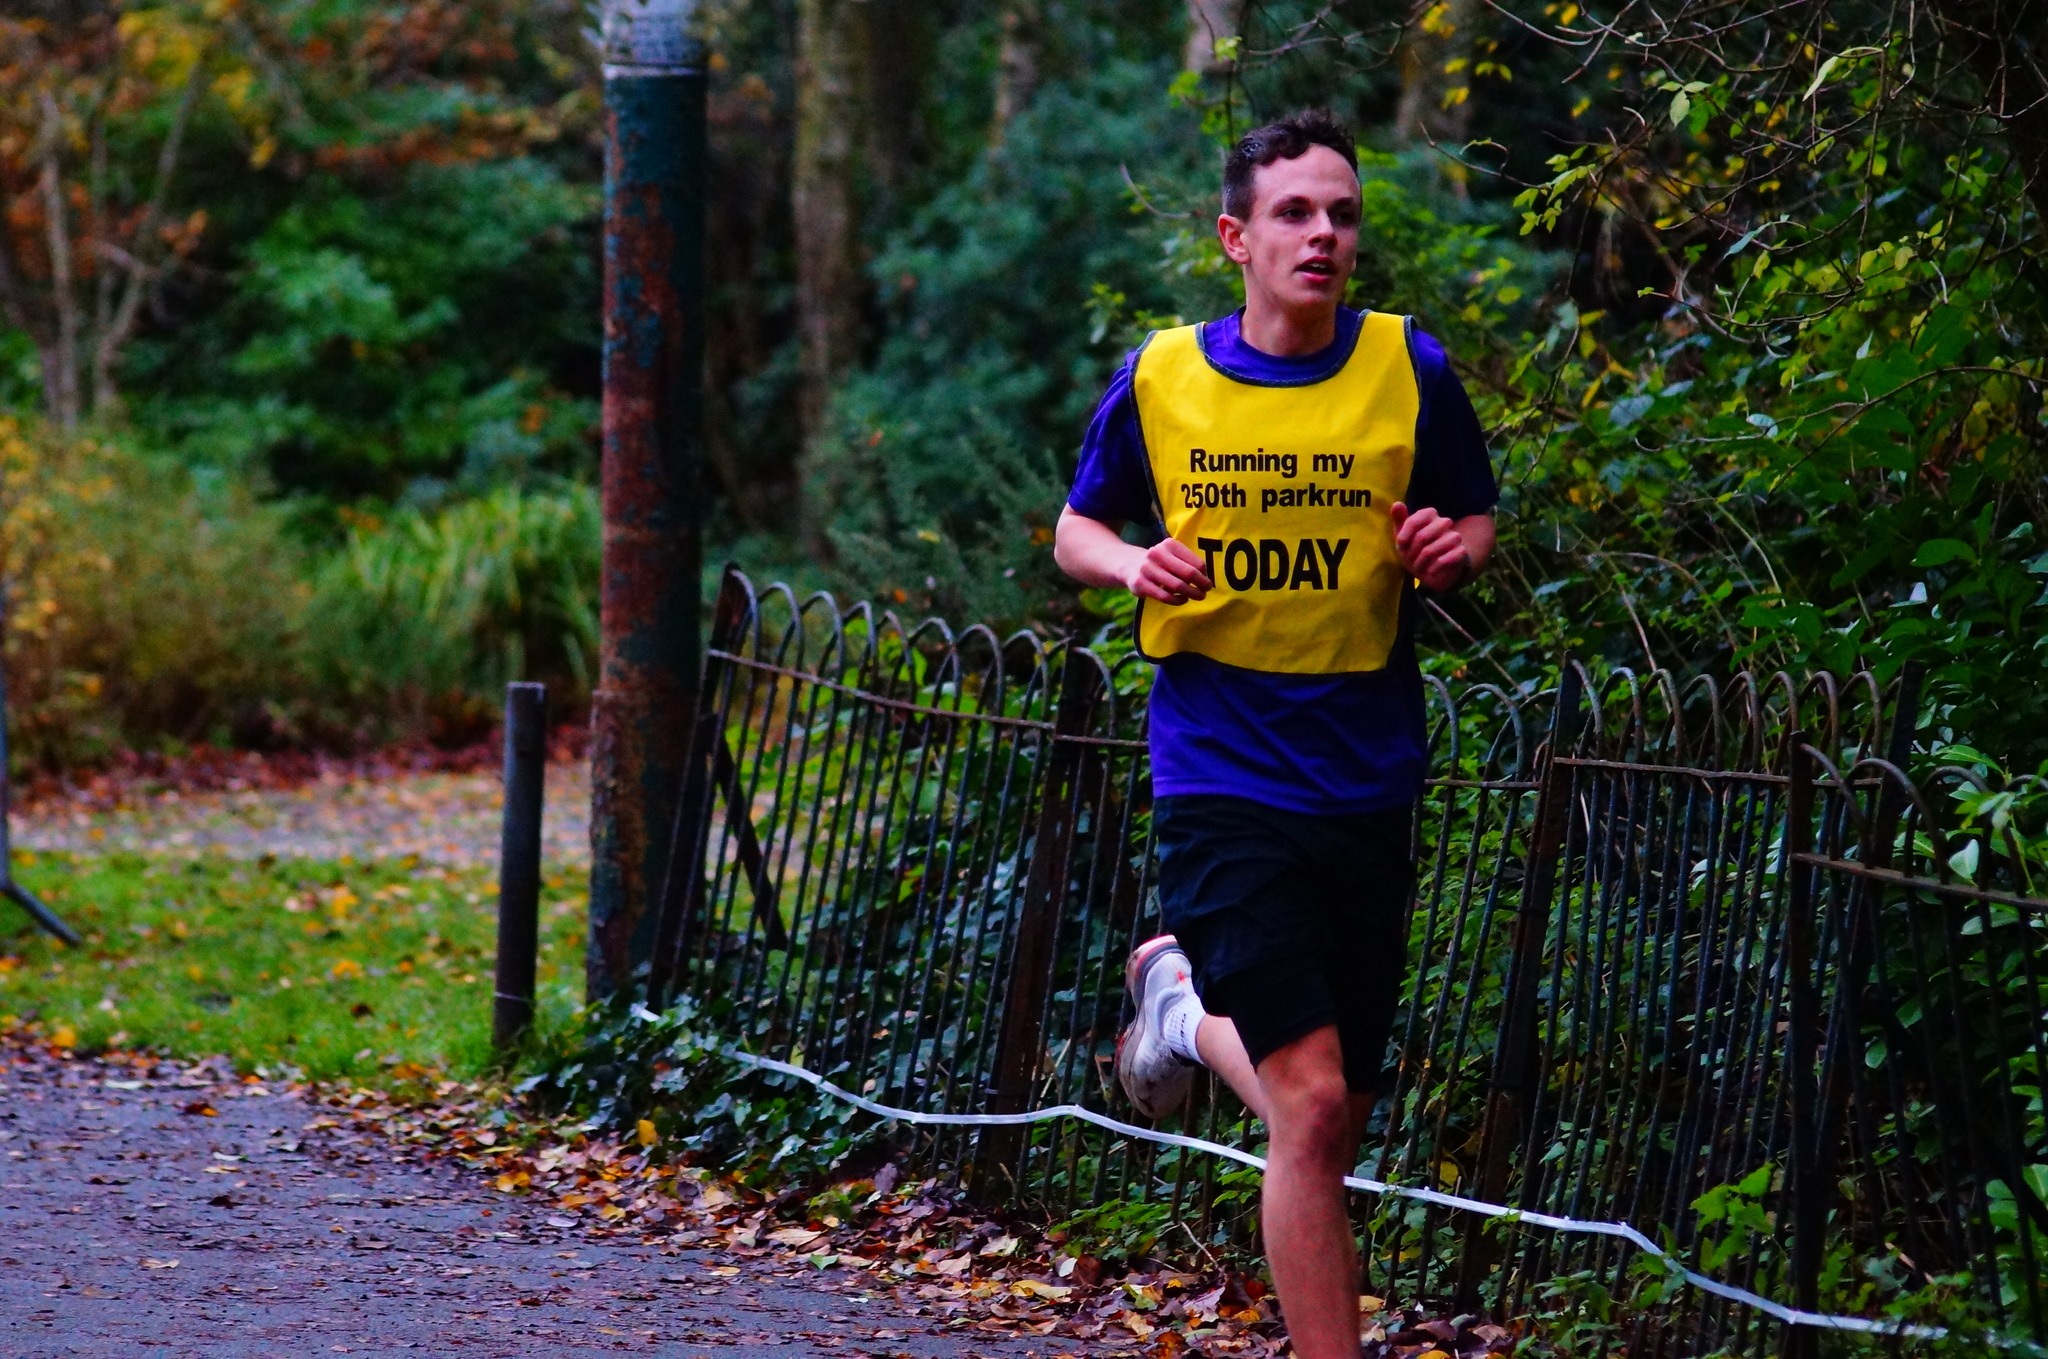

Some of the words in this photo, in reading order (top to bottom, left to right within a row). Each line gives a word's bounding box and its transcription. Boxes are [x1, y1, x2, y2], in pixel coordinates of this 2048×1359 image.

[1190, 448, 1298, 478] Running
[1312, 453, 1355, 479] my
[1181, 482, 1246, 508] 250th
[1261, 483, 1371, 513] parkrun
[1197, 537, 1350, 592] TODAY
